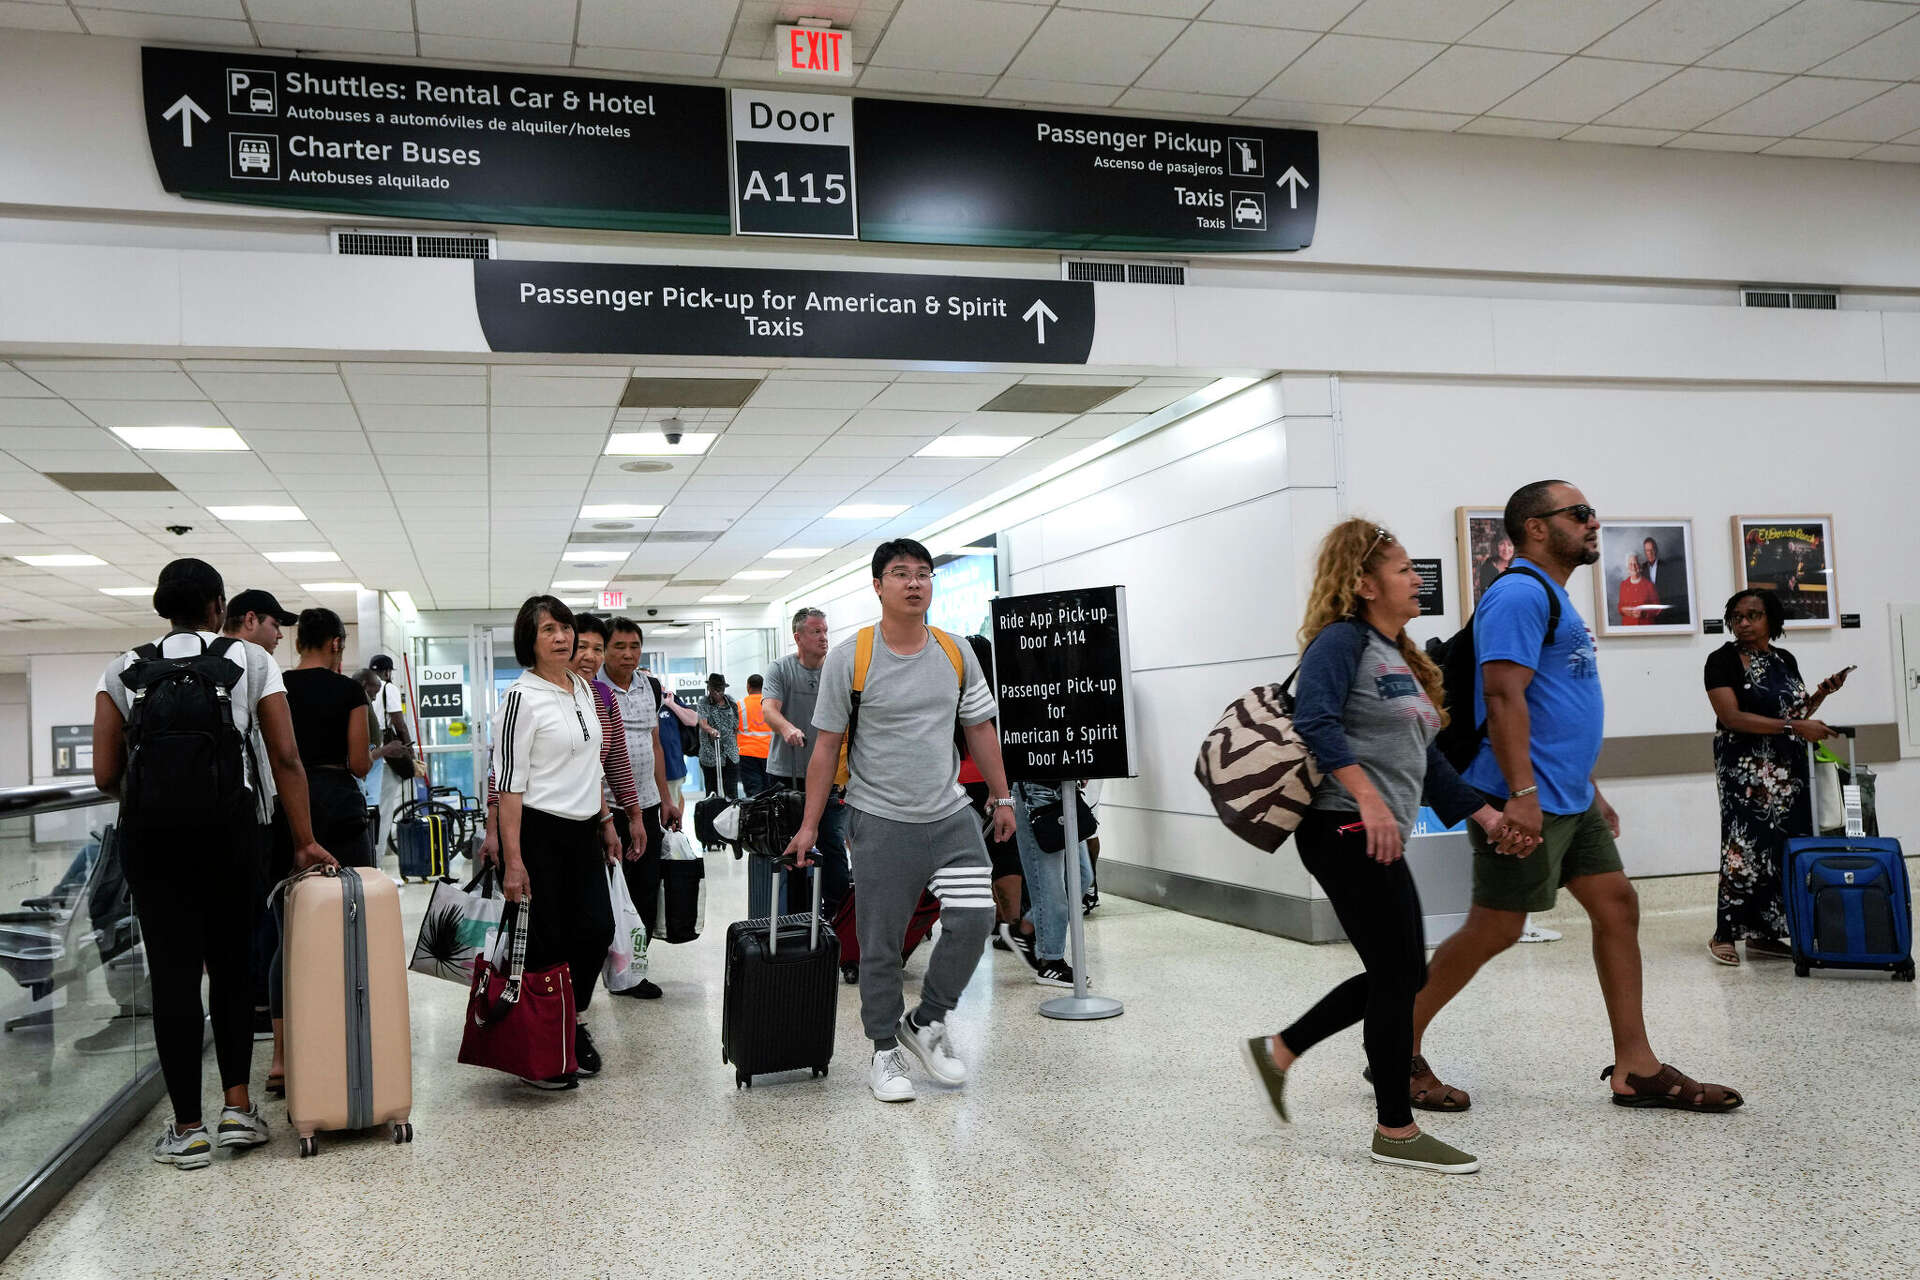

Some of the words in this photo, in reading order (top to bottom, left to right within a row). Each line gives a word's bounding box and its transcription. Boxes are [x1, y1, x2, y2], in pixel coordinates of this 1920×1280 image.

[790, 29, 842, 72] EXIT
[287, 73, 405, 99] Shuttles:
[417, 81, 500, 105] Rental
[510, 88, 553, 108] Car
[564, 91, 580, 110] &
[590, 92, 655, 115] Hotel
[287, 106, 370, 122] Autobuses
[376, 114, 384, 123] a
[390, 114, 483, 129] automóviles
[489, 118, 506, 130] de
[512, 120, 630, 138] alquiler/hoteles
[750, 102, 834, 132] Door
[289, 136, 392, 160] Charter
[403, 142, 480, 166] Buses
[1038, 124, 1146, 151] Passenger
[1155, 132, 1221, 158] Pickup
[1094, 156, 1144, 170] Ascenso
[1149, 160, 1163, 171] de
[1168, 163, 1223, 176] pasajeros
[289, 169, 373, 185] Autobuses
[378, 174, 450, 190] alquilado
[744, 171, 846, 204] A115
[1174, 187, 1224, 207] Taxis
[1197, 217, 1226, 229] Taxis
[520, 283, 653, 311] Passenger
[664, 288, 753, 314] Pick-up
[762, 290, 796, 310] for
[805, 292, 916, 314] American
[926, 296, 940, 314] &
[948, 297, 1007, 321] Spirit
[745, 316, 803, 336] Taxis
[604, 592, 623, 607] EXIT
[1000, 614, 1024, 629] Ride
[1030, 612, 1052, 630] App
[1059, 606, 1107, 624] Pick-up
[1020, 636, 1047, 649] Door
[1054, 630, 1086, 646] A-114
[424, 670, 456, 680] Door
[1002, 683, 1060, 700] Passenger
[1068, 677, 1116, 695] Pick-up
[421, 693, 461, 707] A115
[1048, 704, 1065, 718] for
[1004, 728, 1059, 744] American
[1067, 728, 1074, 741] &
[1081, 724, 1118, 744] Spirit
[1029, 752, 1056, 766] Door
[1063, 749, 1093, 764] A-115
